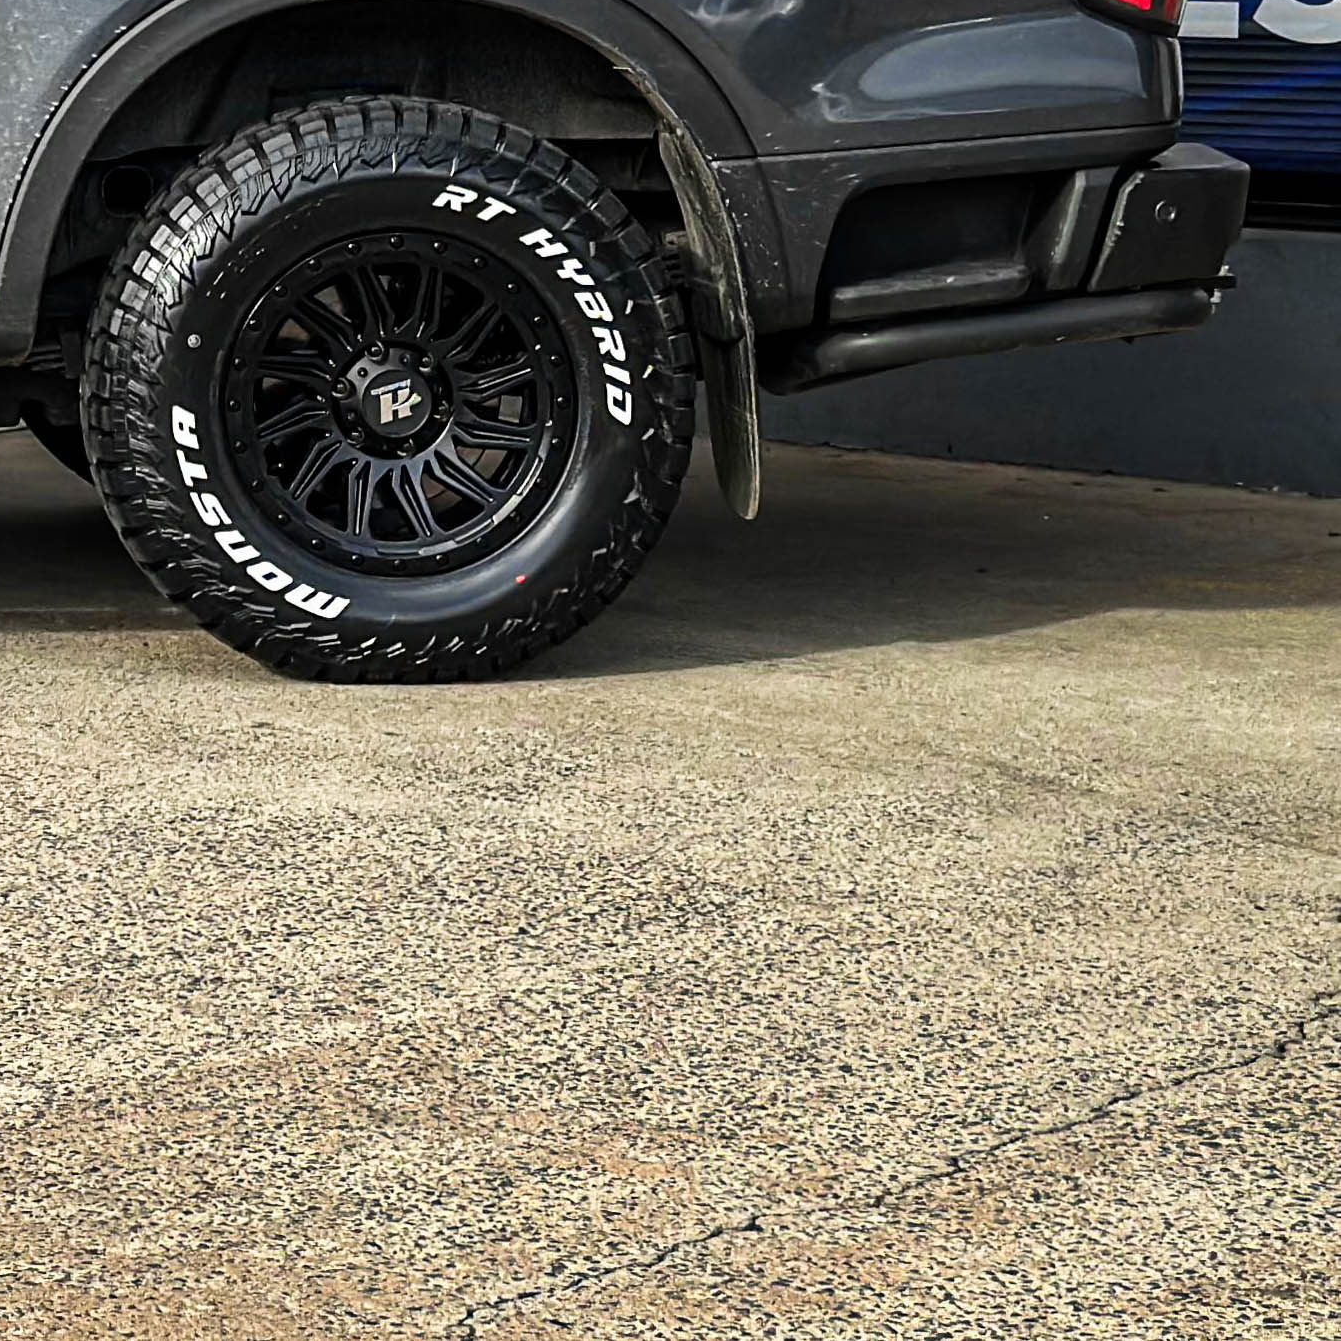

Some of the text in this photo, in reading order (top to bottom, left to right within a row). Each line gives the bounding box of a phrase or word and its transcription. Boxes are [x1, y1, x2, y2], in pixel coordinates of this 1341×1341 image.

[431, 183, 634, 427] RT HYBRID
[170, 404, 352, 621] MONSTA
